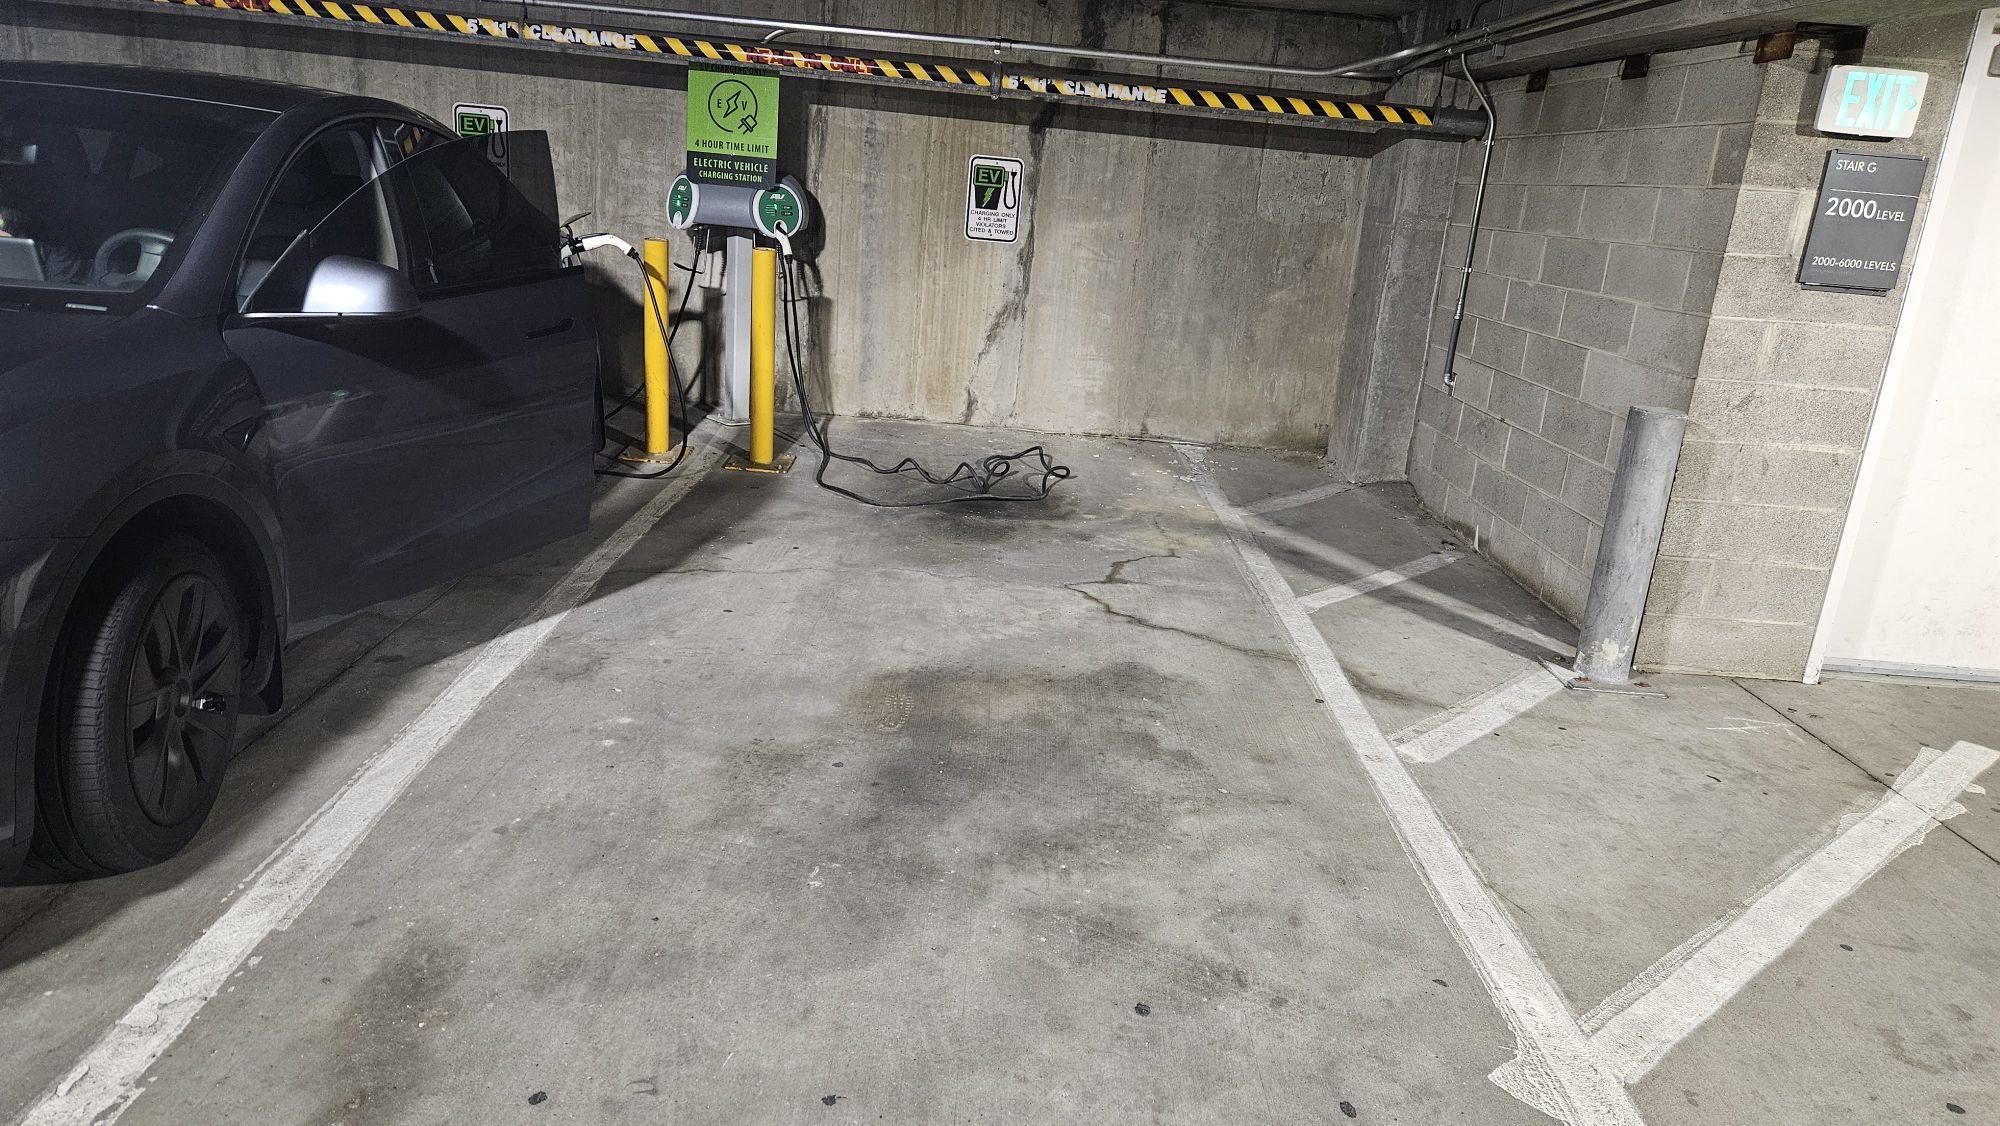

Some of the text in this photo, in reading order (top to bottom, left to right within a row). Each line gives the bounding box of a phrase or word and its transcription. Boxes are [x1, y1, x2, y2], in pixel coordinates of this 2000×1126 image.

[529, 24, 637, 50] CLEARANCE
[830, 57, 876, 75] ONLY
[1063, 80, 1167, 104] CLEARANCE
[717, 99, 747, 110] E V
[1835, 71, 1917, 131] EXIT
[463, 117, 486, 131] EV
[694, 139, 769, 153] 4 HOUR TIME LIMIT
[693, 157, 769, 173] ELECTRIC VEHICLE
[1836, 160, 1877, 173] STAIR G
[699, 170, 762, 183] CHARGING STATION
[978, 169, 1001, 183] EV
[1824, 197, 1905, 222] 2000 LEVEL
[975, 221, 1006, 229] VIOLATORS
[1812, 256, 1897, 272] 2000-6000 LEVELS
